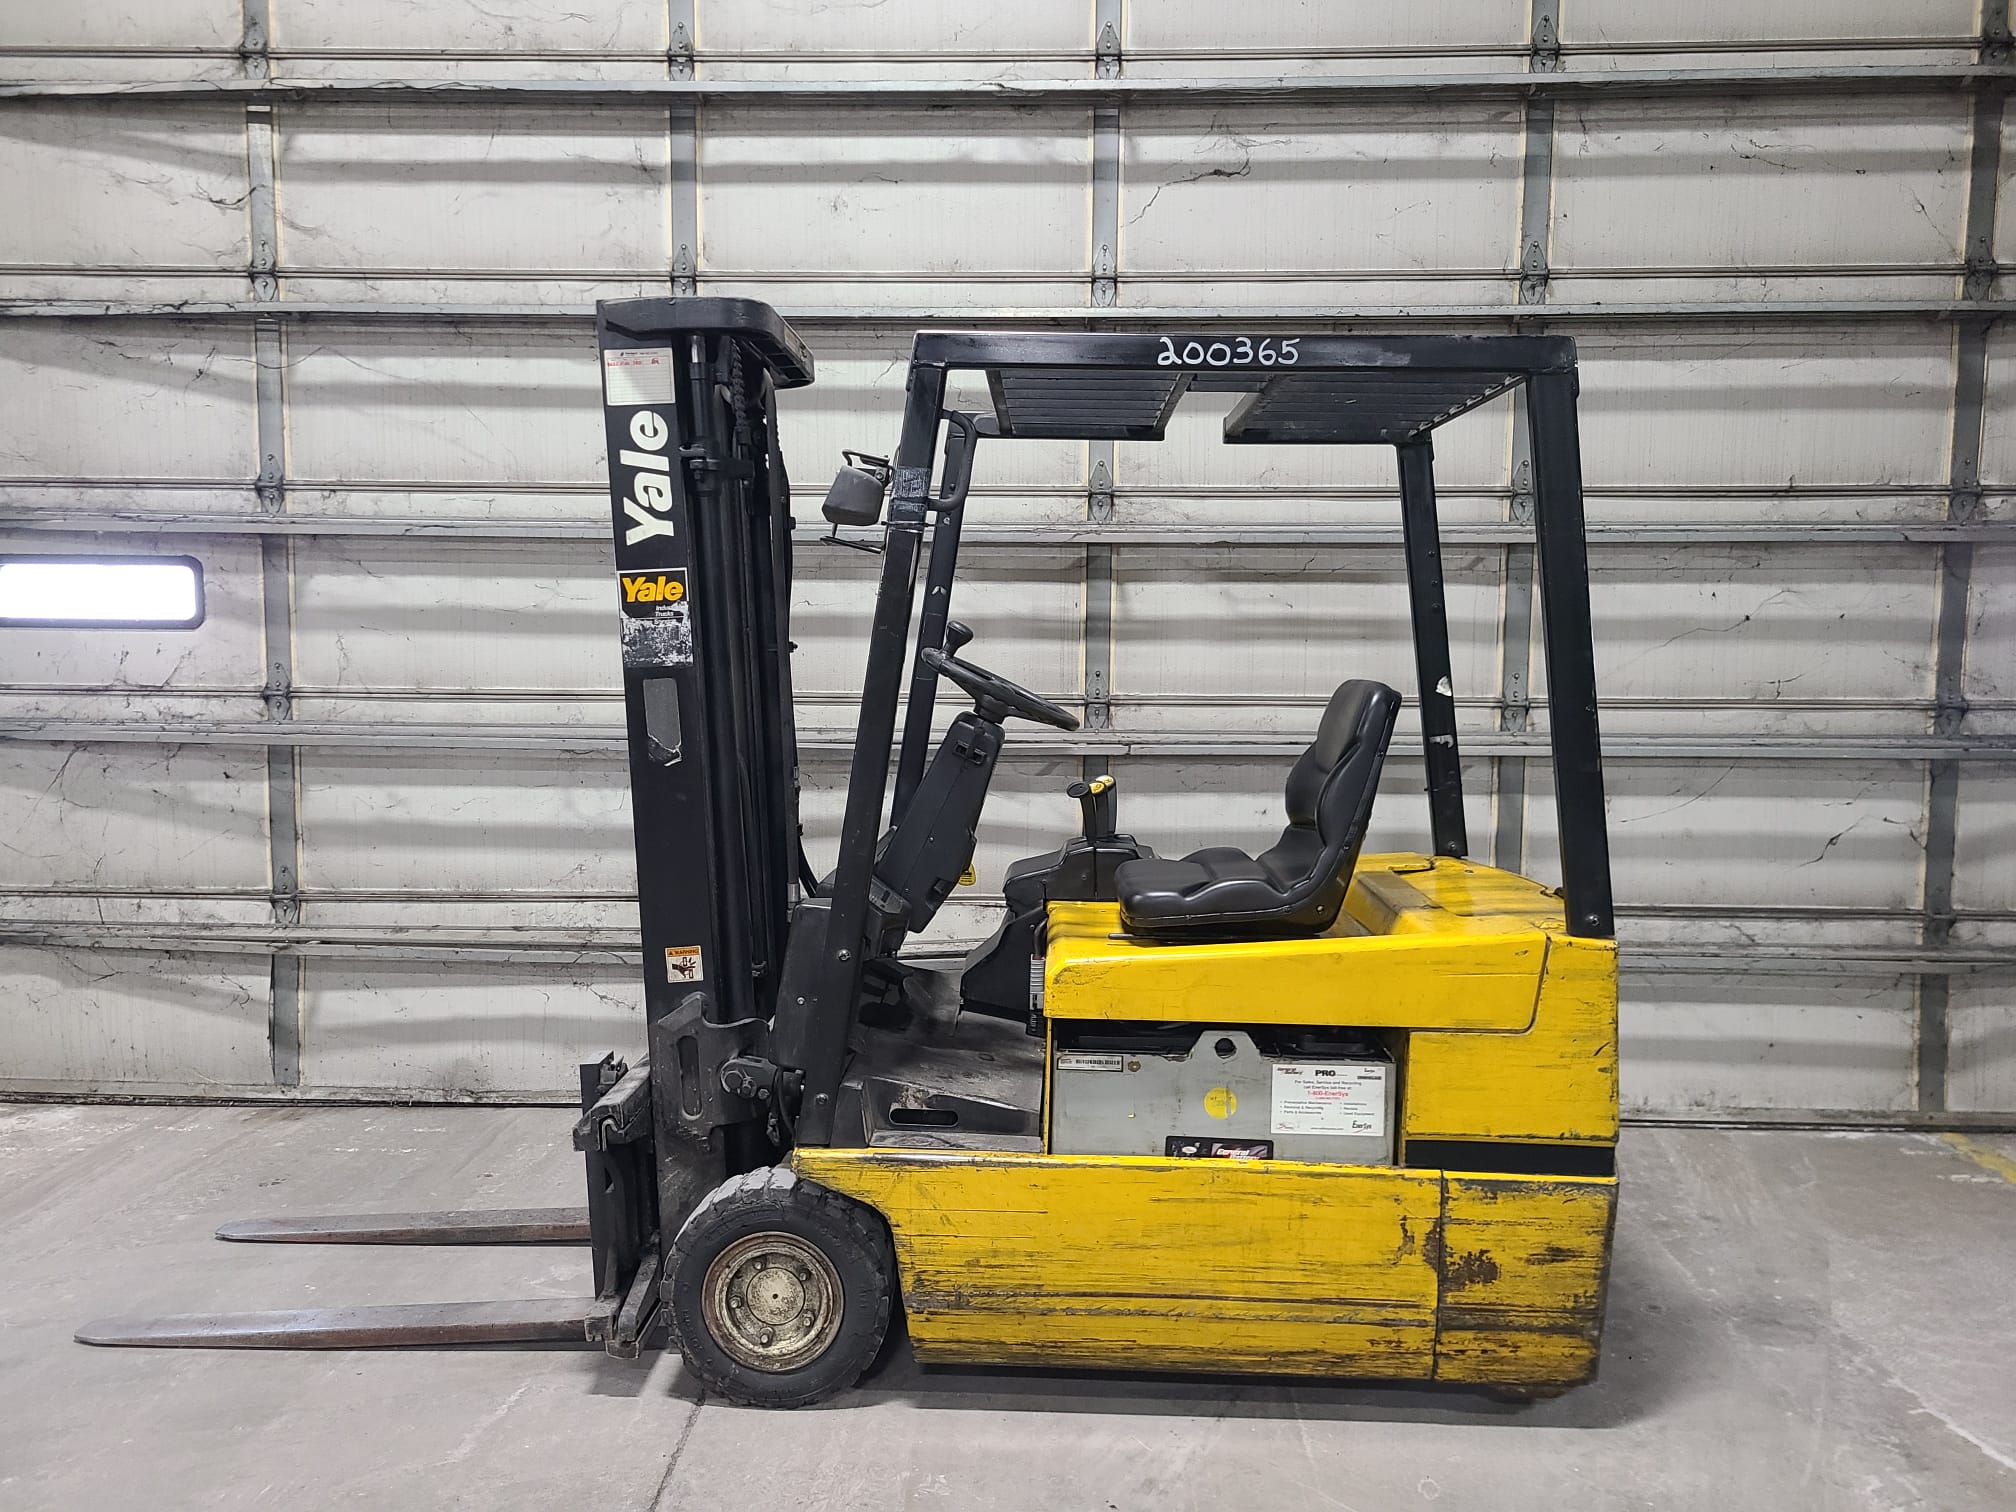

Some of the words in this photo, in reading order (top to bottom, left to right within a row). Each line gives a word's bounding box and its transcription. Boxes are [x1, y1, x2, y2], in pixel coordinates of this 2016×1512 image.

[1157, 336, 1300, 366] 200365
[620, 410, 674, 546] Yale
[622, 576, 684, 602] Yale
[1315, 1069, 1336, 1077] PRO
